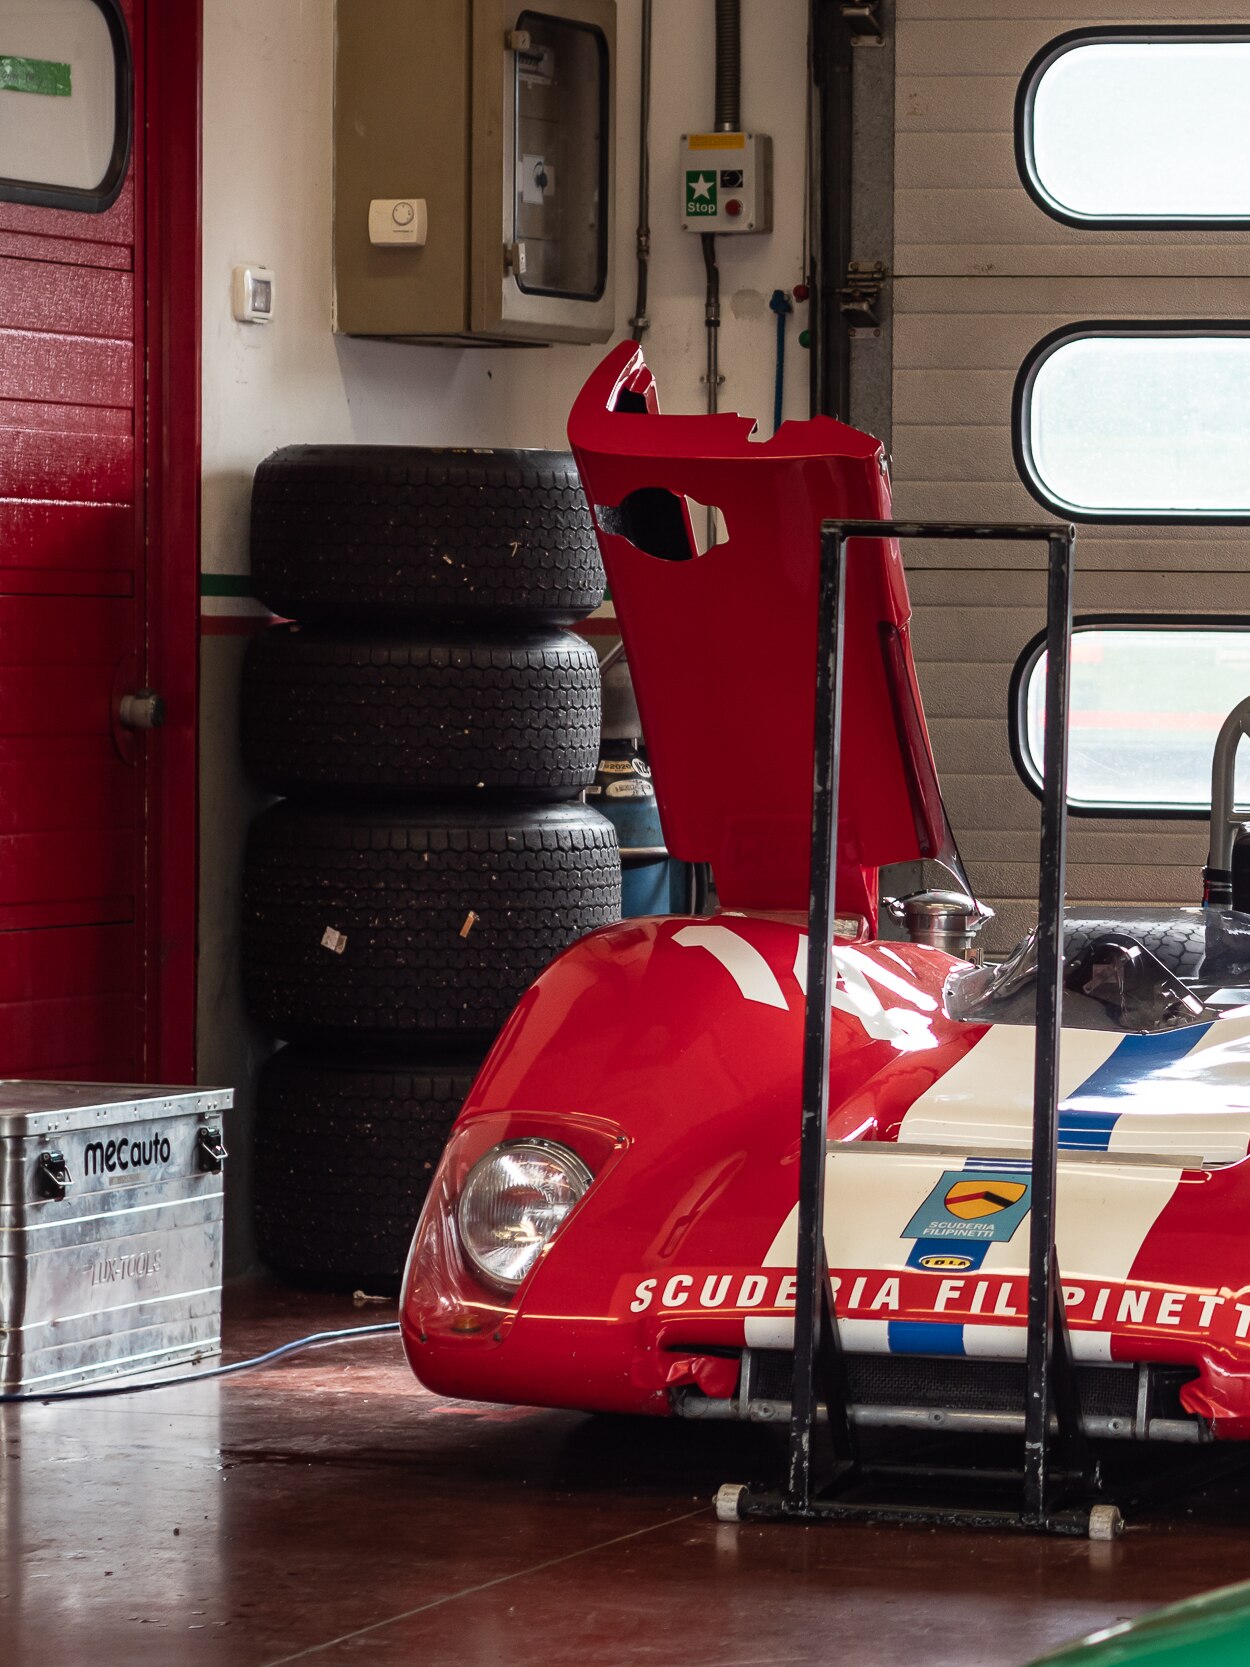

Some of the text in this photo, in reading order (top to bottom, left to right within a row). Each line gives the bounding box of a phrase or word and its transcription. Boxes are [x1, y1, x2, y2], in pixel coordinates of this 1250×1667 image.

[687, 201, 716, 214] Stop
[84, 1131, 171, 1176] mecauto
[928, 1221, 995, 1231] SCUDERIA
[922, 1228, 995, 1238] FILIPINETTI
[630, 1274, 900, 1313] SCUDEIA
